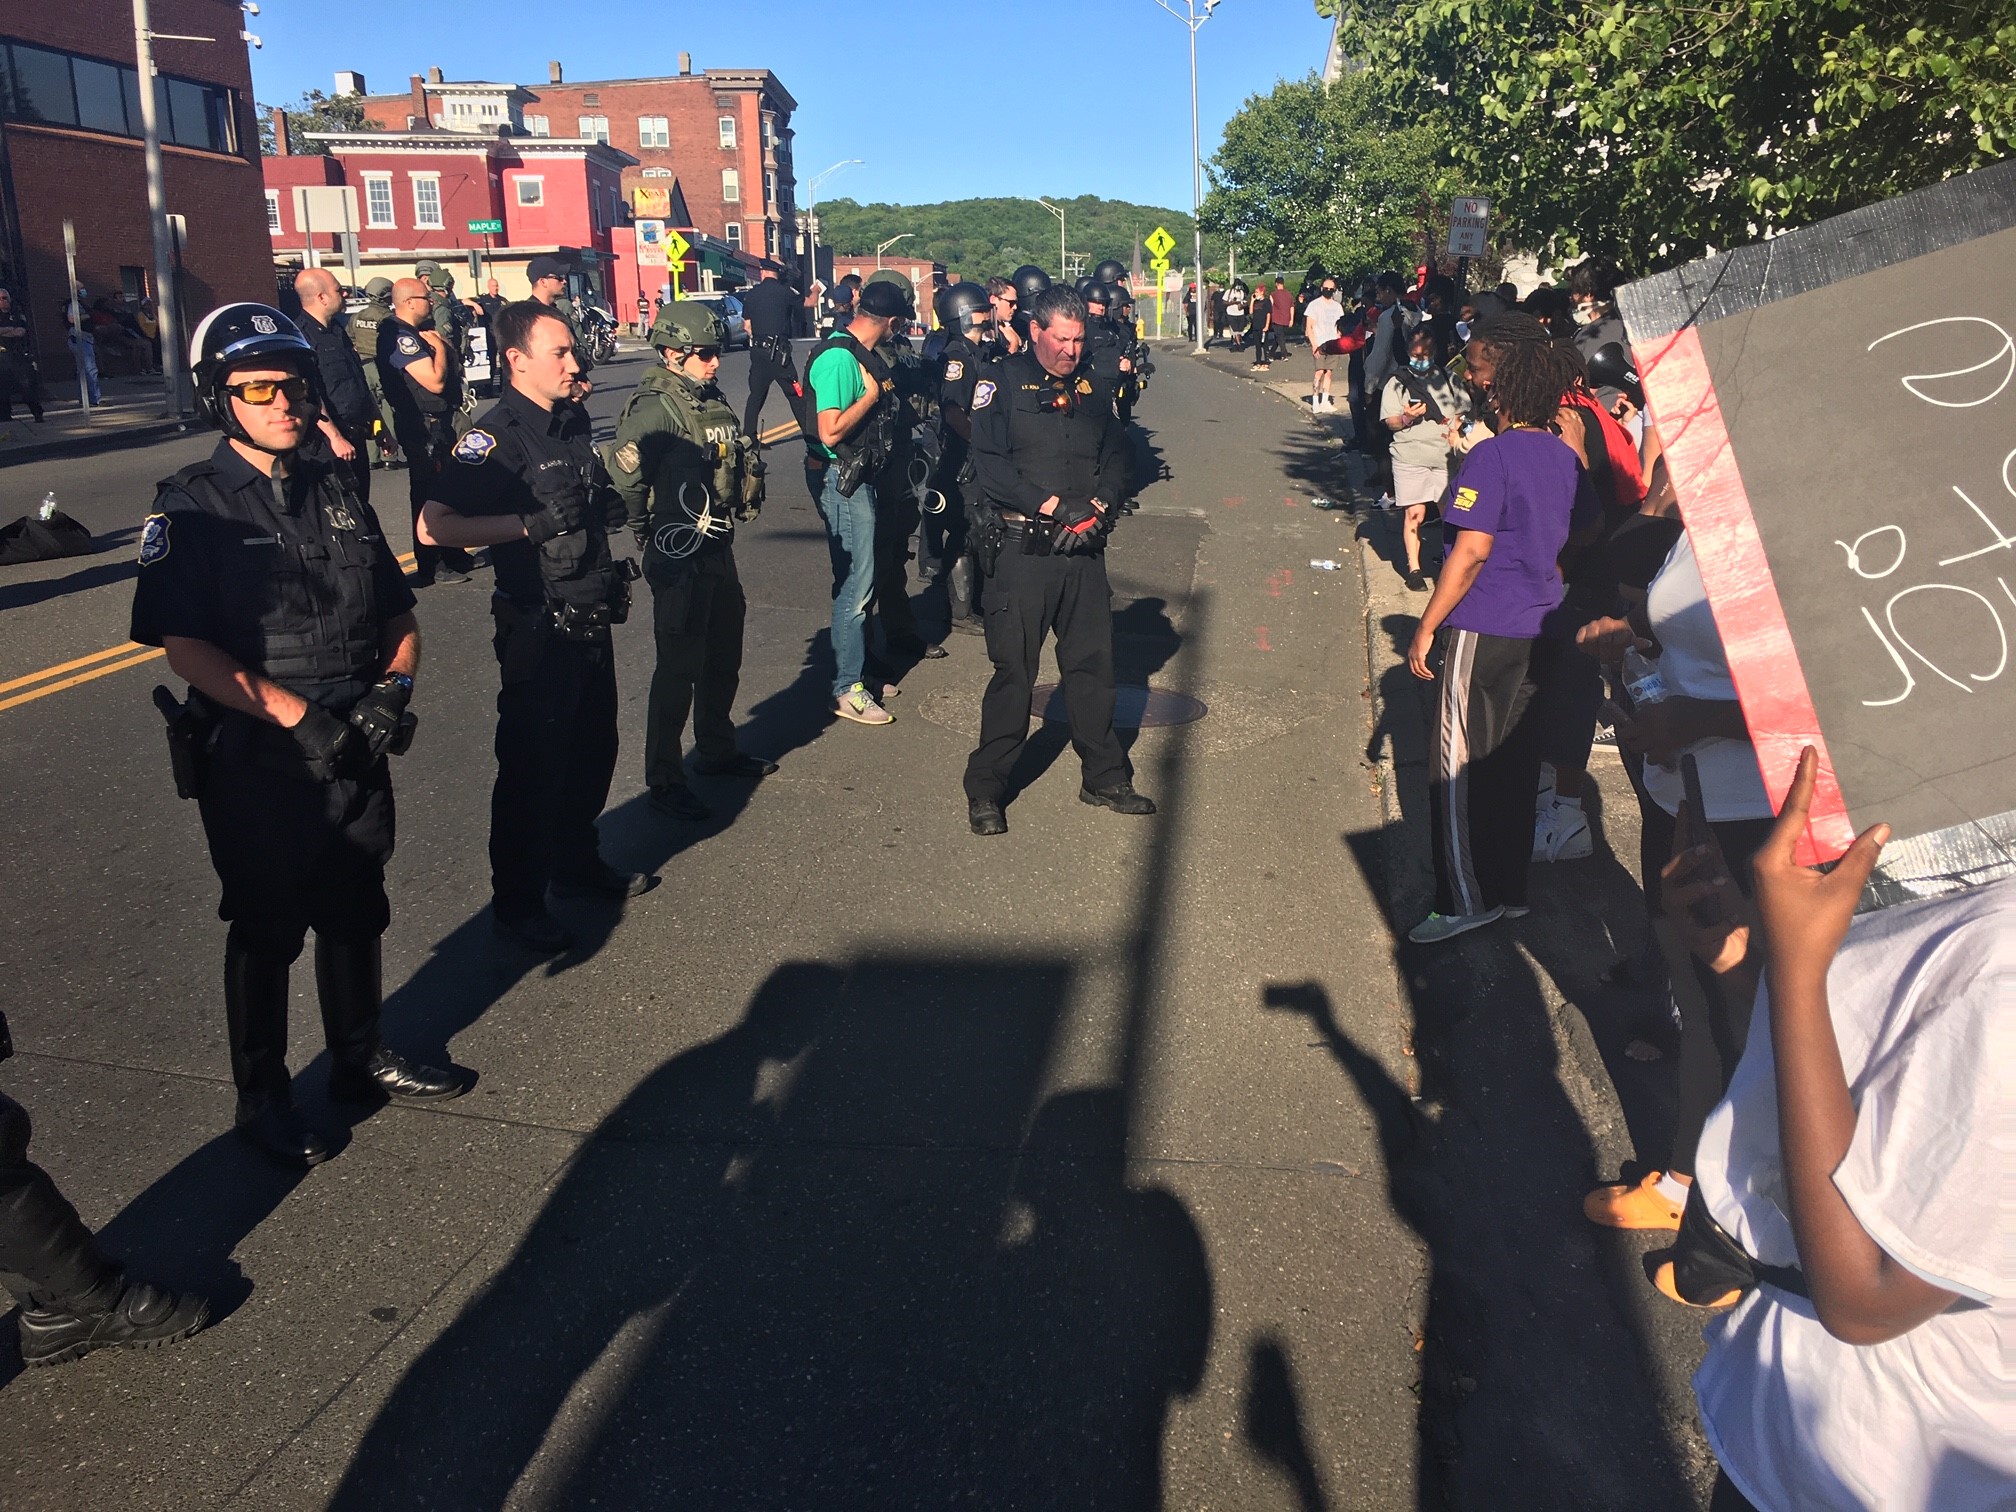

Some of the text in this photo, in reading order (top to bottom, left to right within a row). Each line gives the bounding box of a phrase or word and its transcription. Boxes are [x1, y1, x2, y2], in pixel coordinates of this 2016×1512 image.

[1464, 202, 1478, 213] NO
[469, 223, 497, 231] MAPLE
[1452, 216, 1486, 229] PARKING
[1460, 232, 1474, 240] ANY
[1458, 243, 1473, 252] TIME
[356, 320, 377, 330] POLICE
